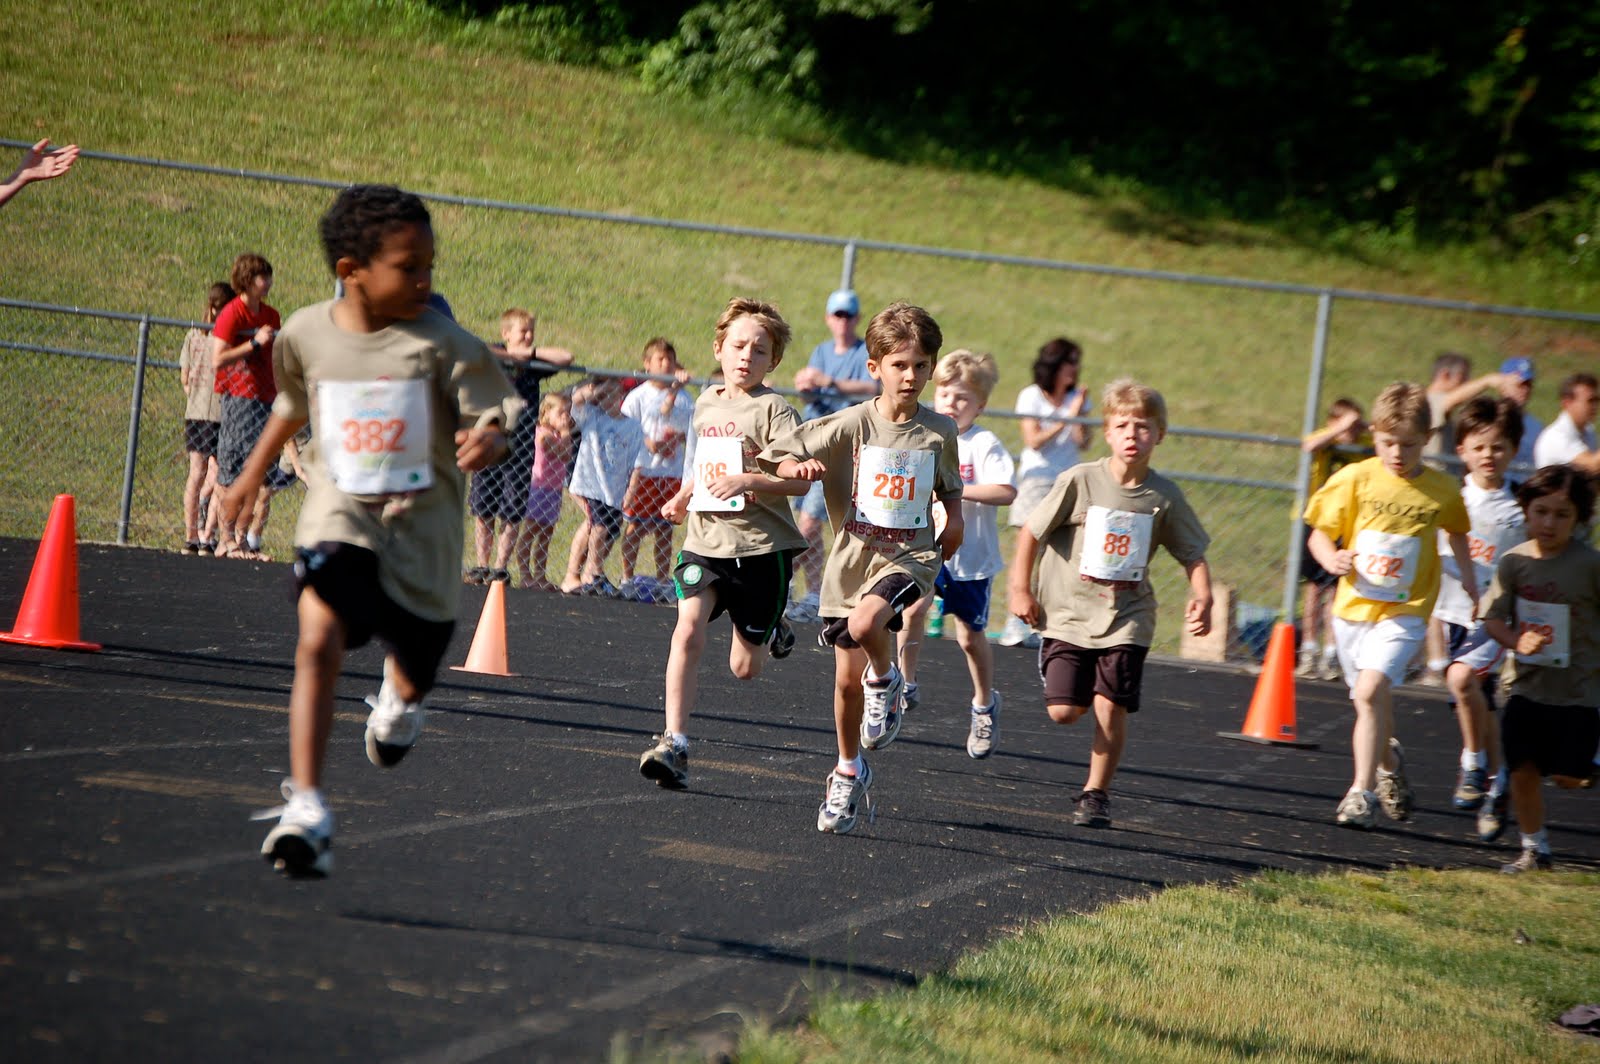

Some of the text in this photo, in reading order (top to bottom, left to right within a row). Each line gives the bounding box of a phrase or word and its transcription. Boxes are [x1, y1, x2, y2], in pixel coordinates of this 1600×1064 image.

[342, 419, 406, 453] 382
[873, 473, 916, 501] 281
[1104, 533, 1131, 556] 88
[1366, 554, 1405, 578] 232
